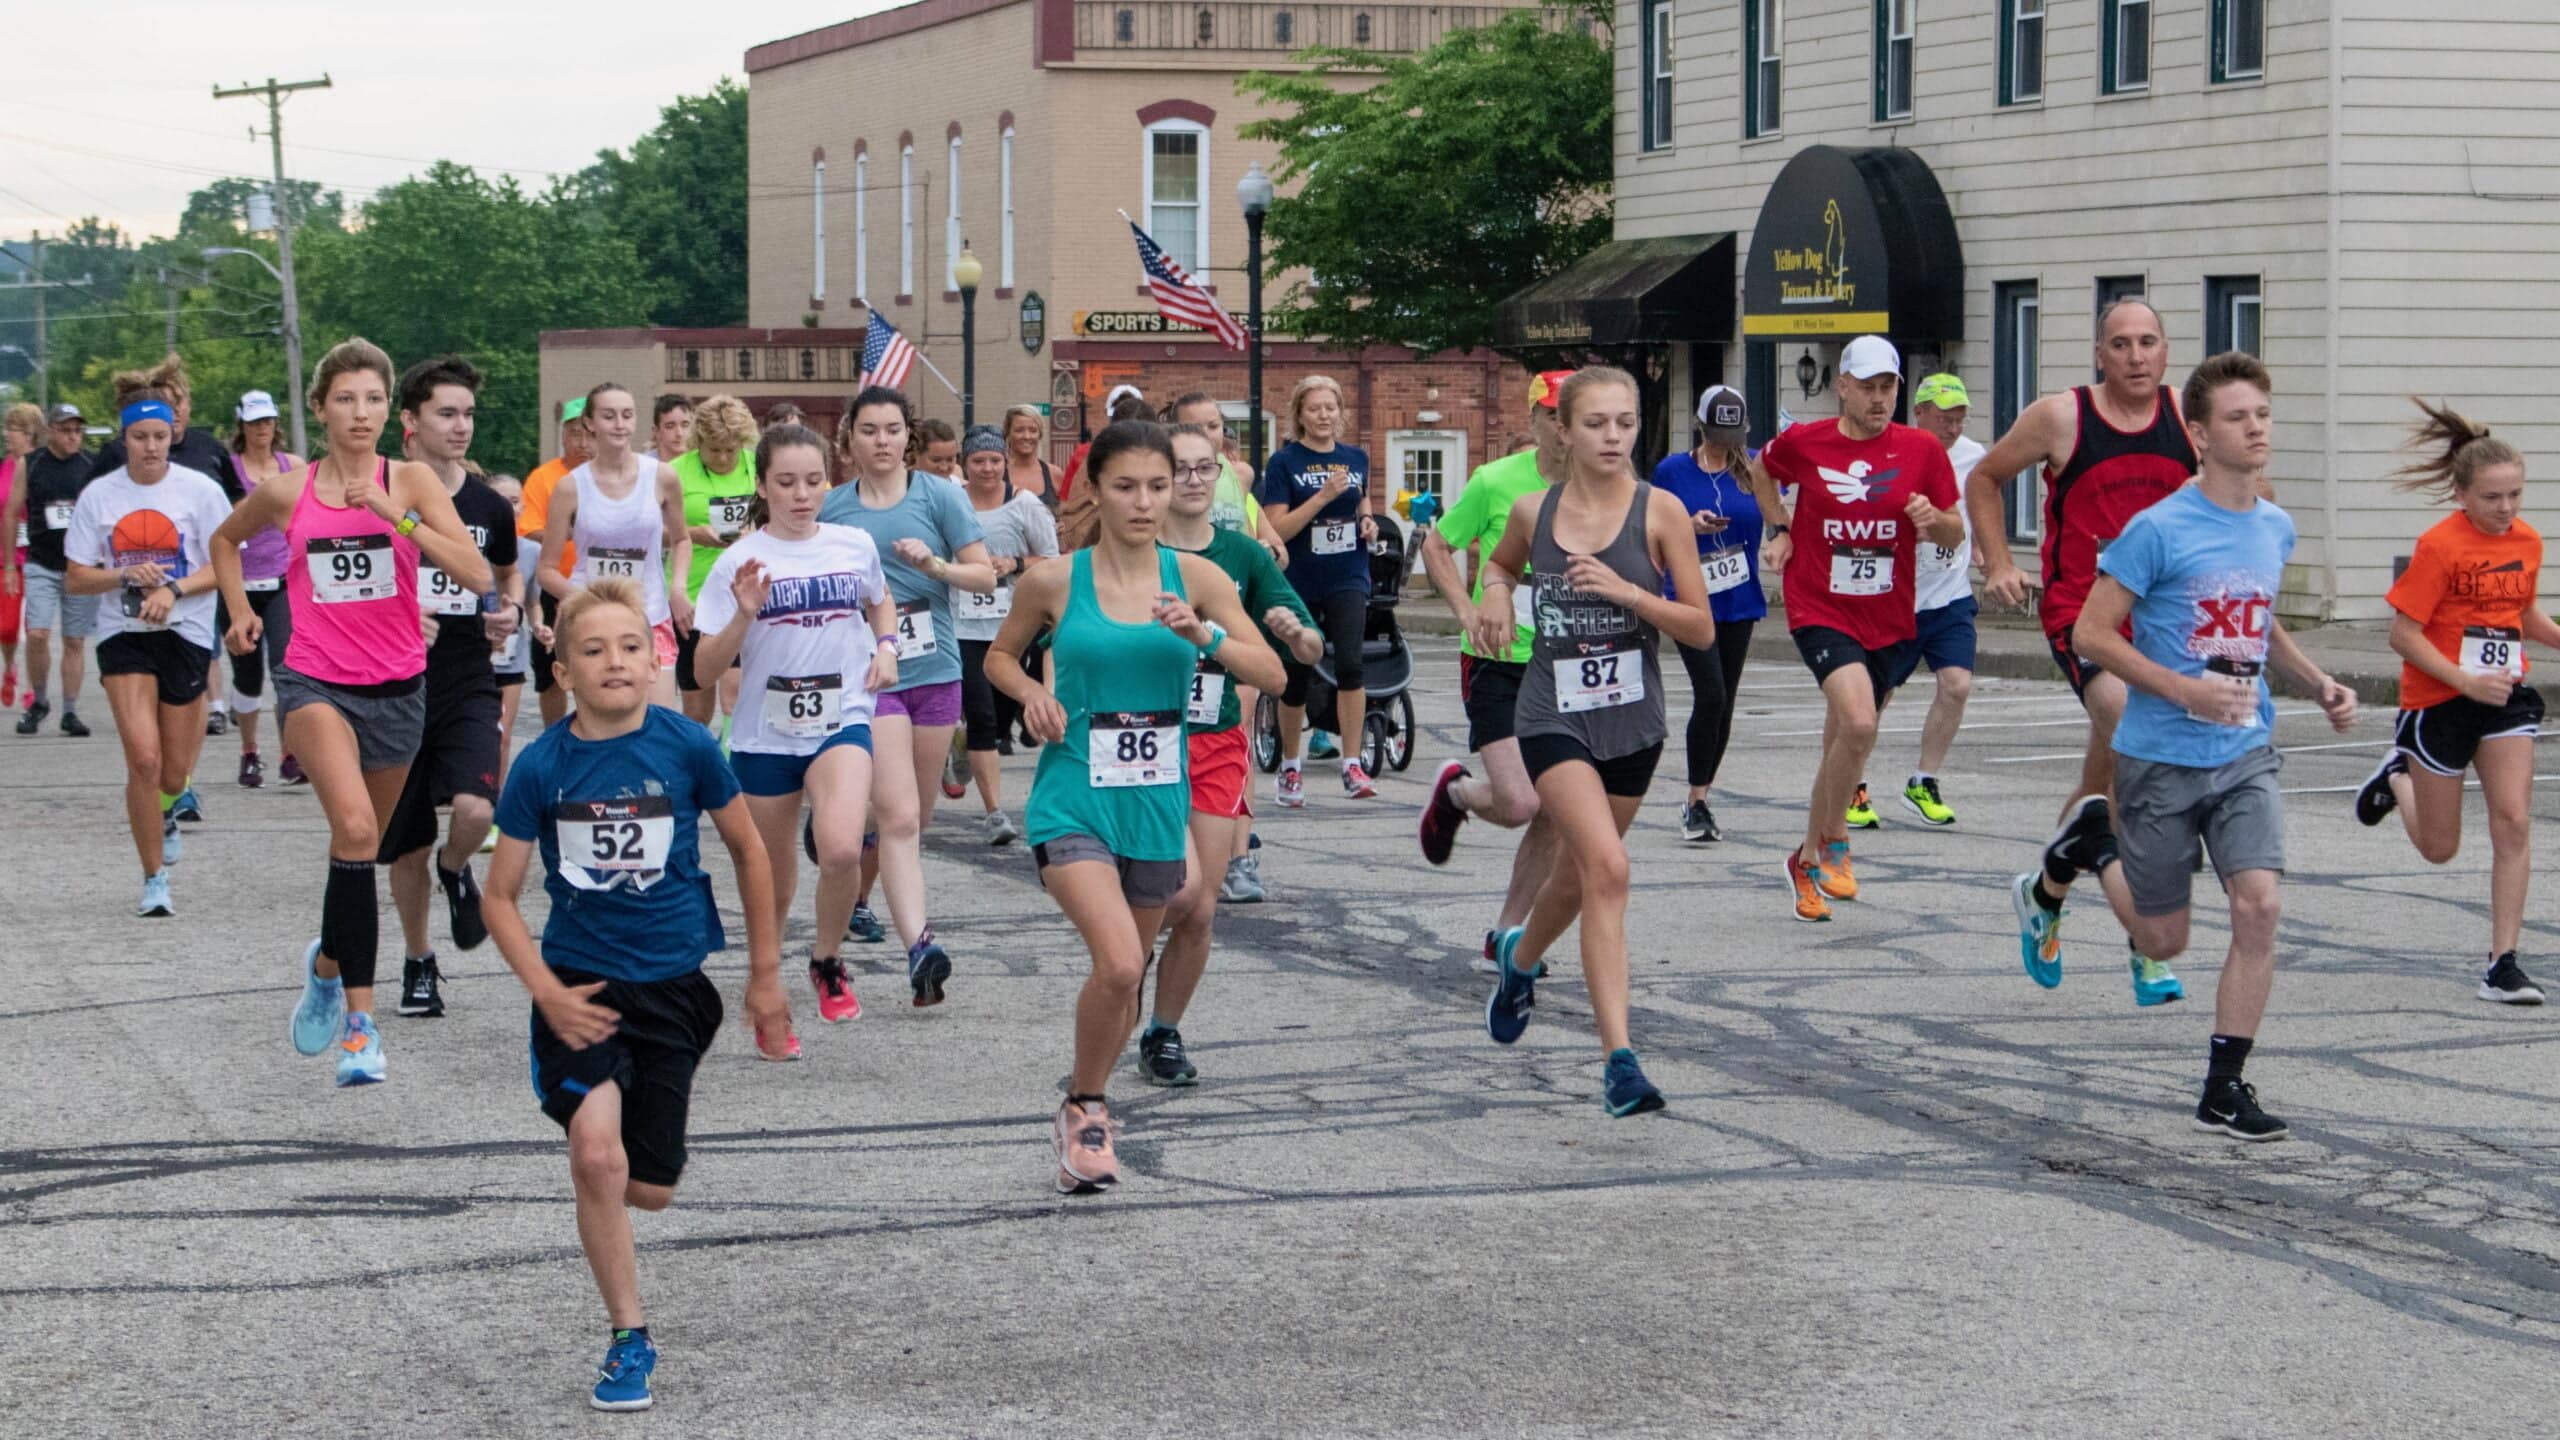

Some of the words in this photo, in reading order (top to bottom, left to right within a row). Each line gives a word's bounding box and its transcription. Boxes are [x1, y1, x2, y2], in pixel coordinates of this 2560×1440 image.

[1774, 249, 1803, 271] Yellow
[1804, 248, 1823, 275] Dog
[1781, 281, 1812, 299] Tavern
[1814, 280, 1822, 298] &
[1825, 279, 1856, 306] Eatery
[1091, 314, 1161, 331] SPORTS
[723, 505, 746, 522] 82
[1326, 527, 1344, 543] 67
[1823, 519, 1897, 540] RWB
[332, 553, 372, 582] 99
[597, 560, 633, 577] 103
[1707, 558, 1739, 581] 102
[1851, 559, 1877, 579] 75
[762, 578, 811, 613] NIGHT
[802, 614, 824, 628] 5K
[1571, 607, 1639, 635] FIELD
[2481, 642, 2509, 666] 89
[1581, 656, 1618, 689] 87
[789, 692, 823, 719] 63
[1117, 731, 1158, 762] 86
[592, 822, 645, 861] 52
